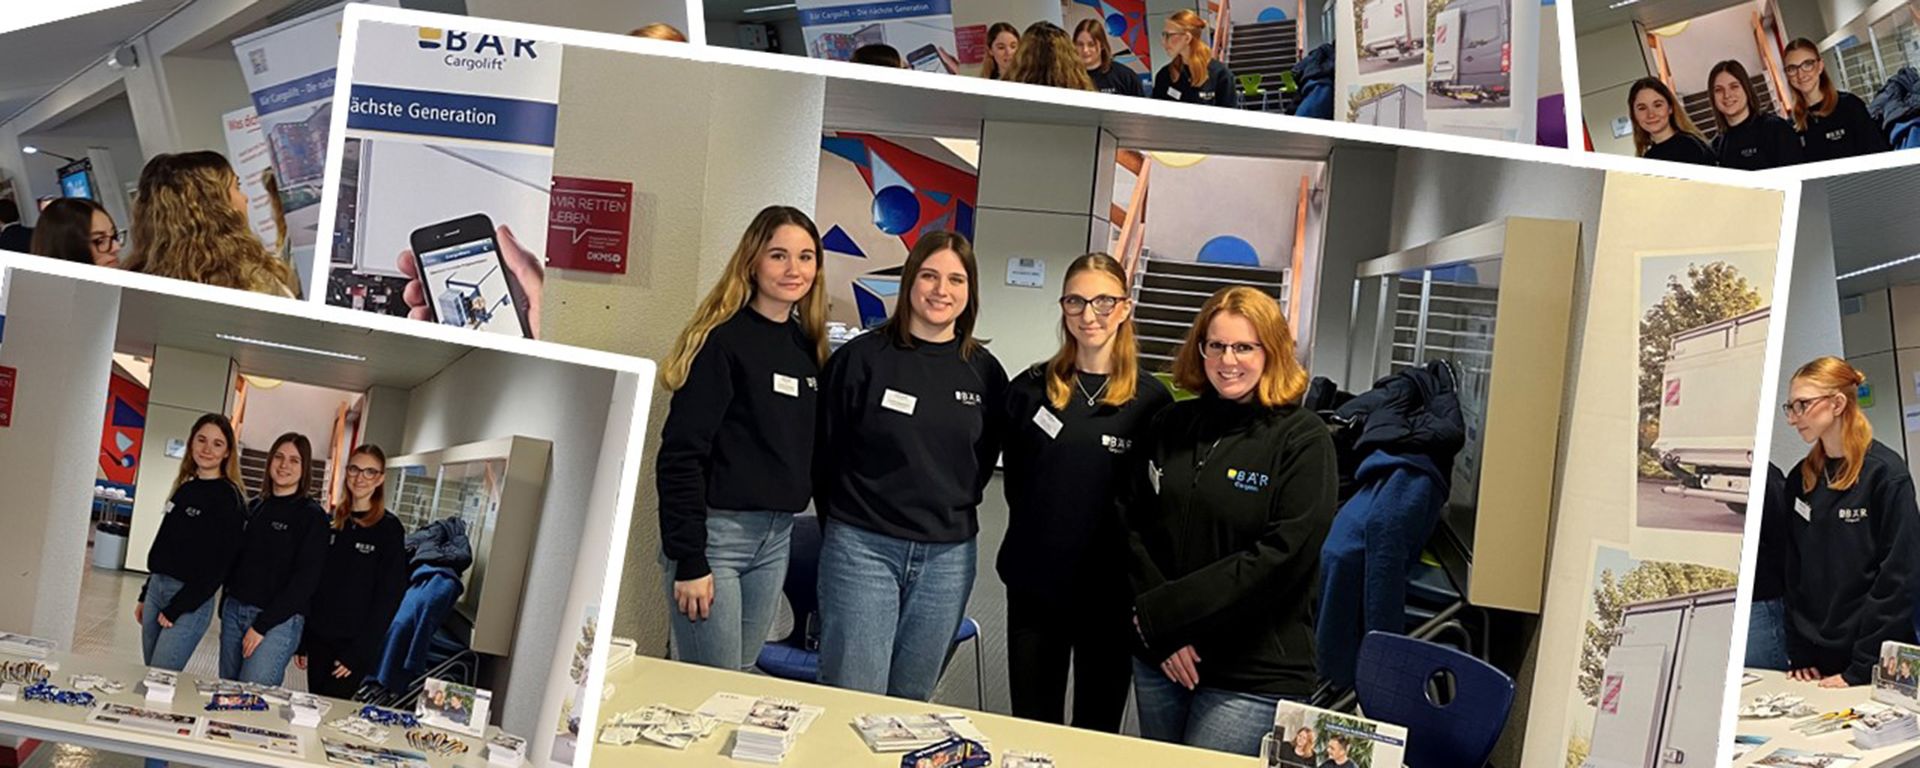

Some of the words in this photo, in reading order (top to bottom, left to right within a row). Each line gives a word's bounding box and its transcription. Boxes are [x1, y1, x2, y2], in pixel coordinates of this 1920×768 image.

[895, 3, 930, 13] Generation
[444, 54, 504, 71] Cargolift
[408, 102, 496, 125] Generation
[551, 195, 576, 209] WIR
[578, 197, 627, 213] RETTEN
[1236, 470, 1269, 487] BÄR
